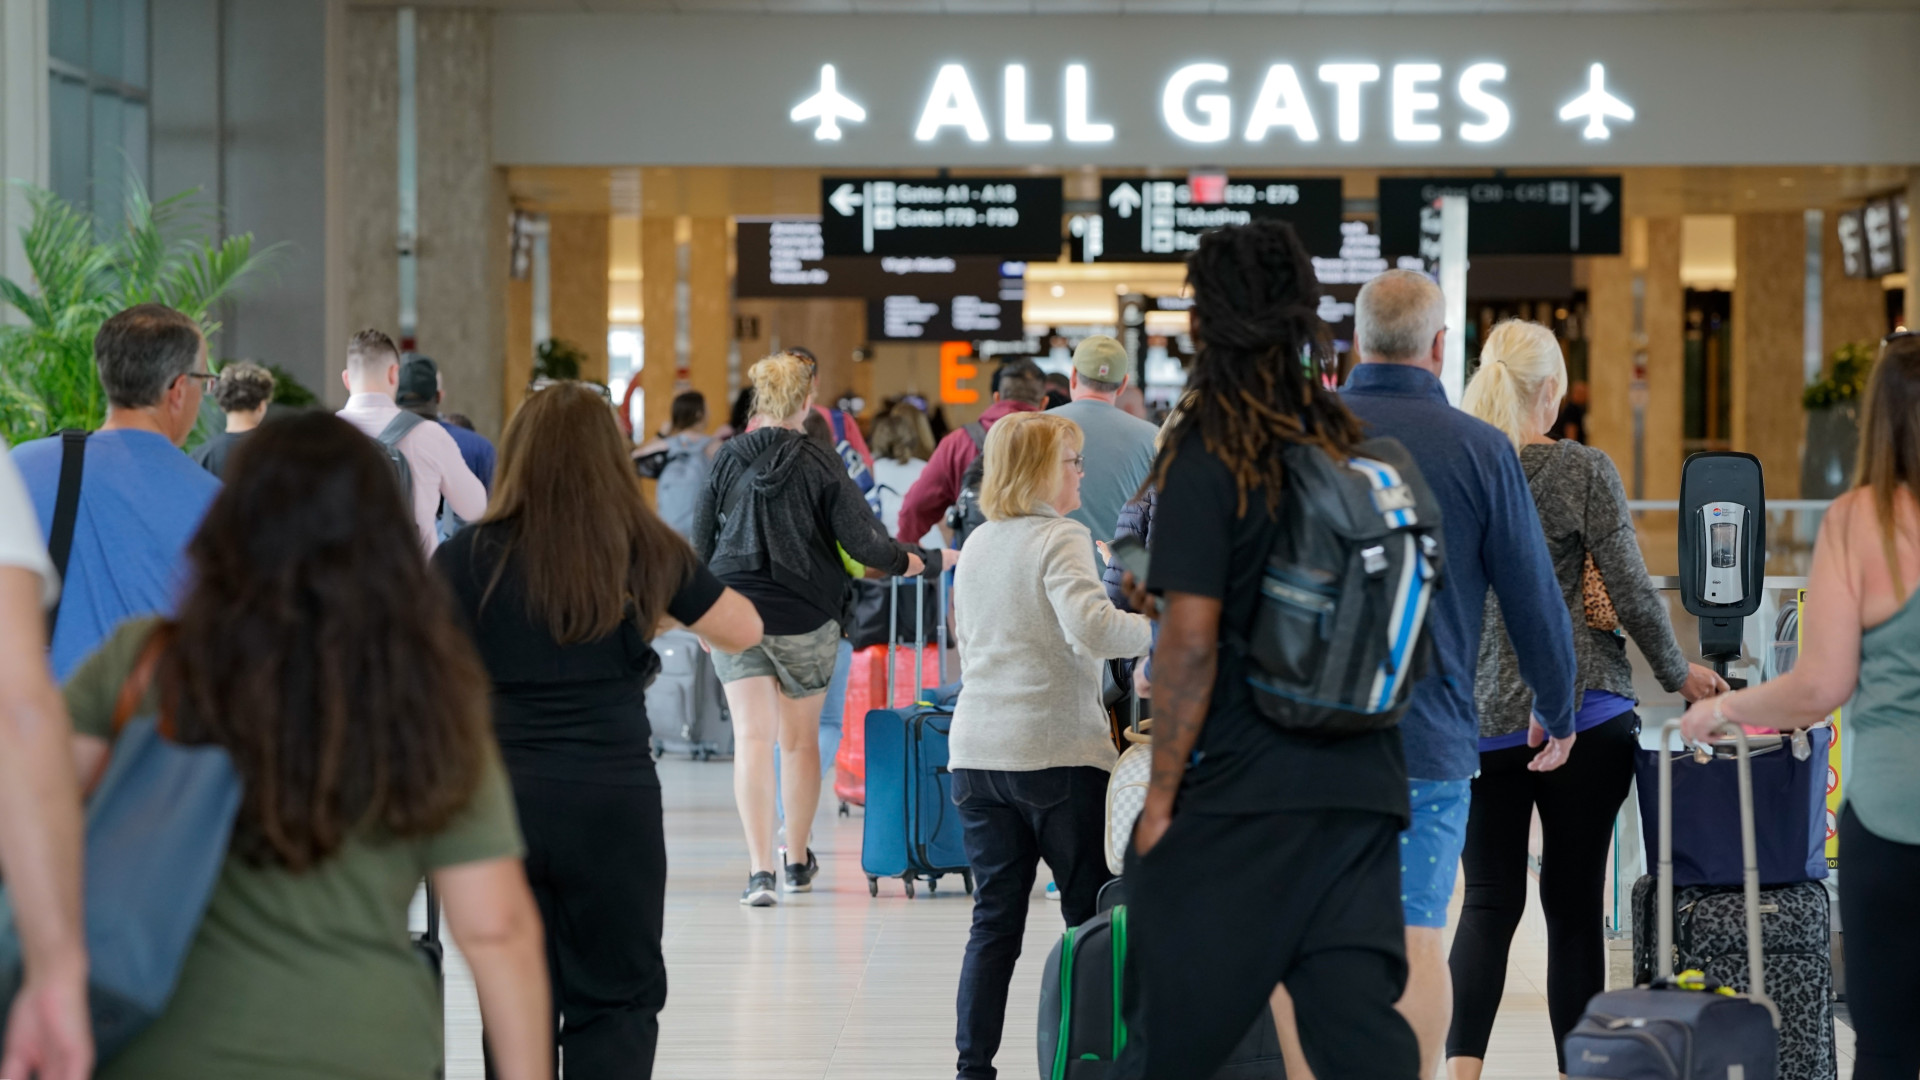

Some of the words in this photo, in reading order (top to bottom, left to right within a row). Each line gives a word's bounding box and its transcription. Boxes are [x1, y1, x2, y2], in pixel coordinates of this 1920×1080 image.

[914, 64, 1116, 142] ALL
[1163, 63, 1511, 144] GATES
[897, 184, 944, 204] Gates
[945, 184, 970, 204] A1
[1266, 185, 1299, 204] E75
[897, 207, 944, 227] Gates
[1176, 207, 1251, 228] Ticketing
[940, 341, 979, 404] E
